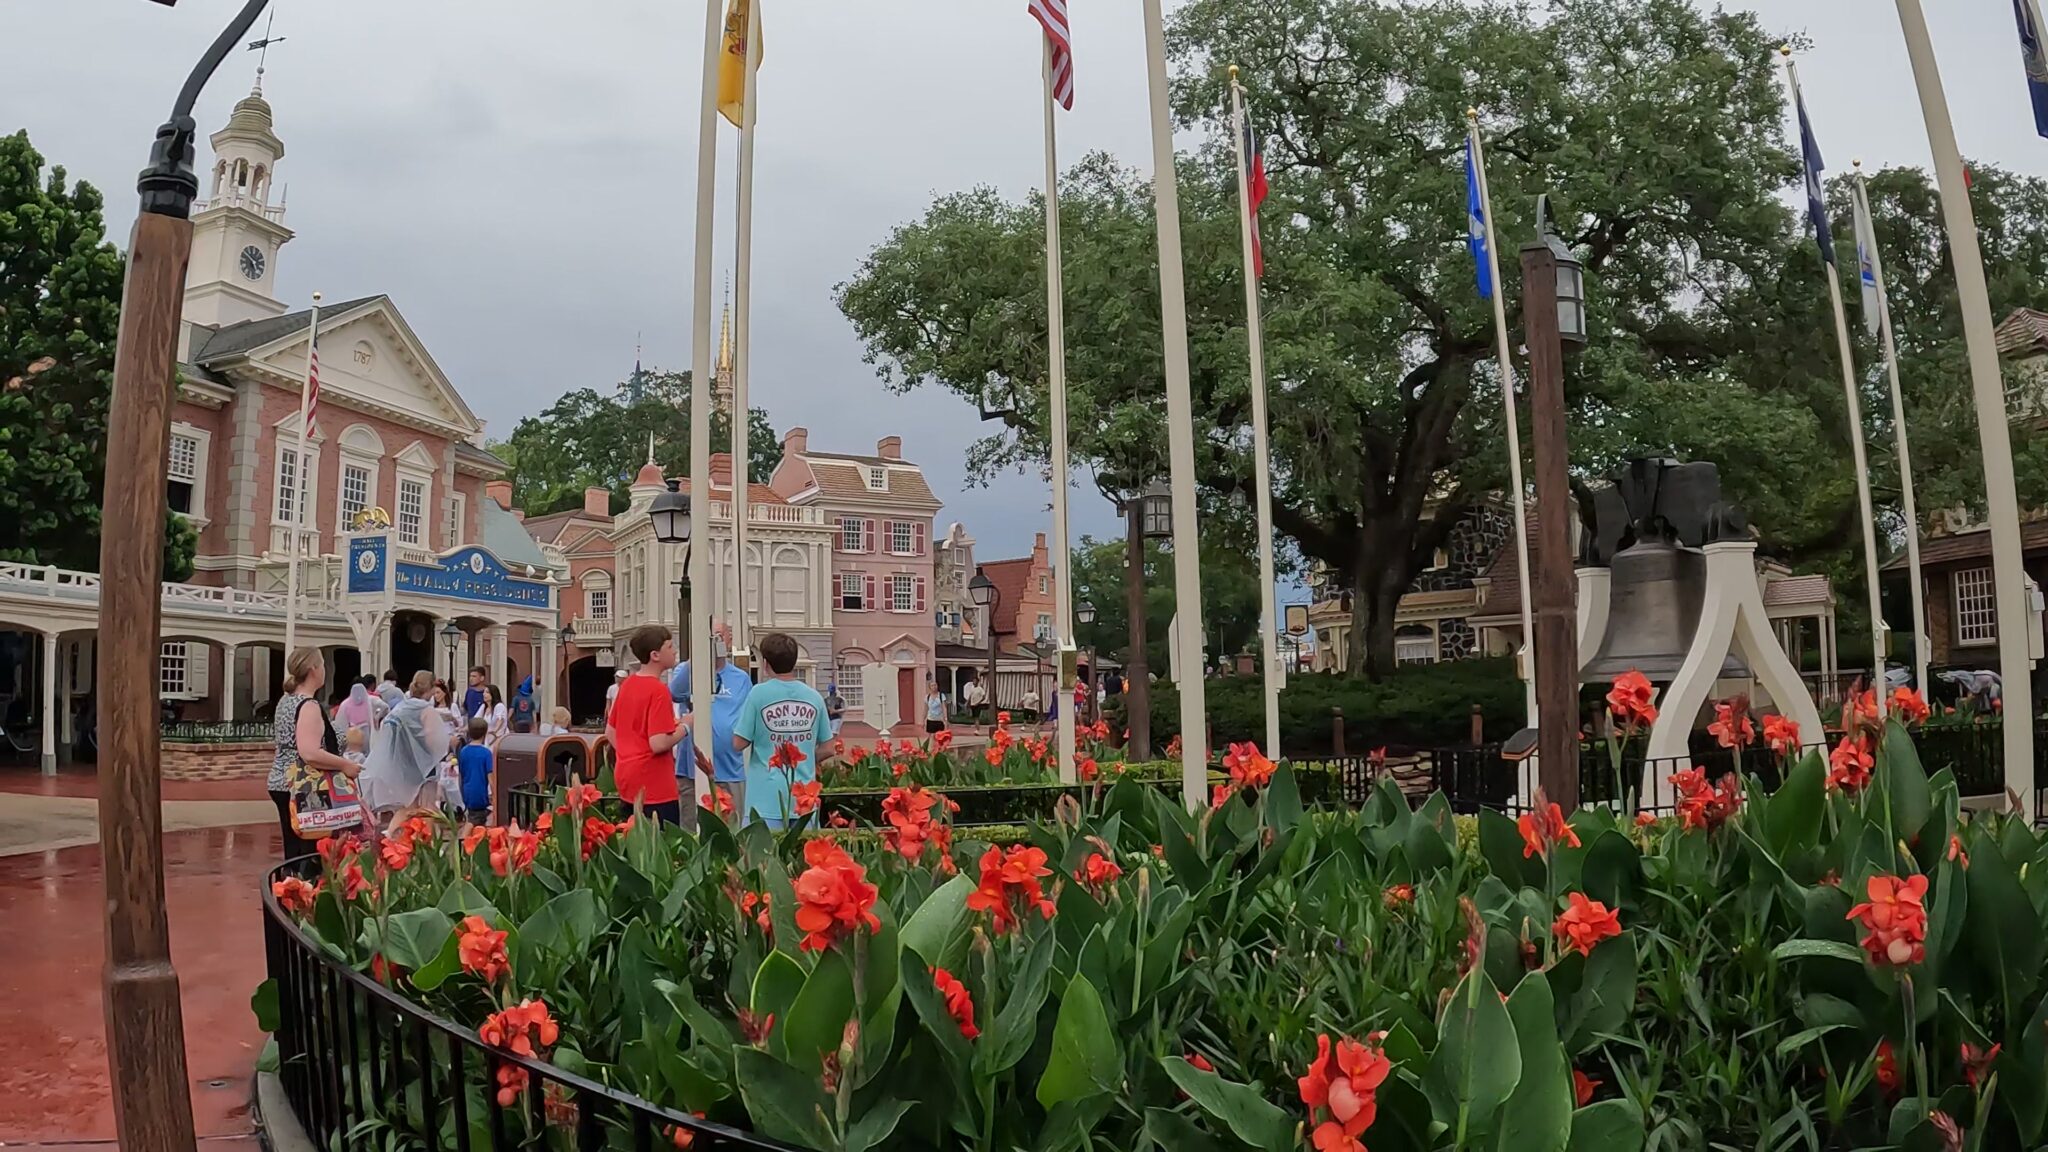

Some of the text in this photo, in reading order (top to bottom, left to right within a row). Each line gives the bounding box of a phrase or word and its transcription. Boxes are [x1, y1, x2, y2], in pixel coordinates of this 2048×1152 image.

[353, 350, 371, 366] 1787
[413, 574, 450, 590] HALL
[766, 704, 815, 723] RON JON
[773, 719, 809, 728] SURF SHOP
[770, 733, 813, 743] ORLANDO
